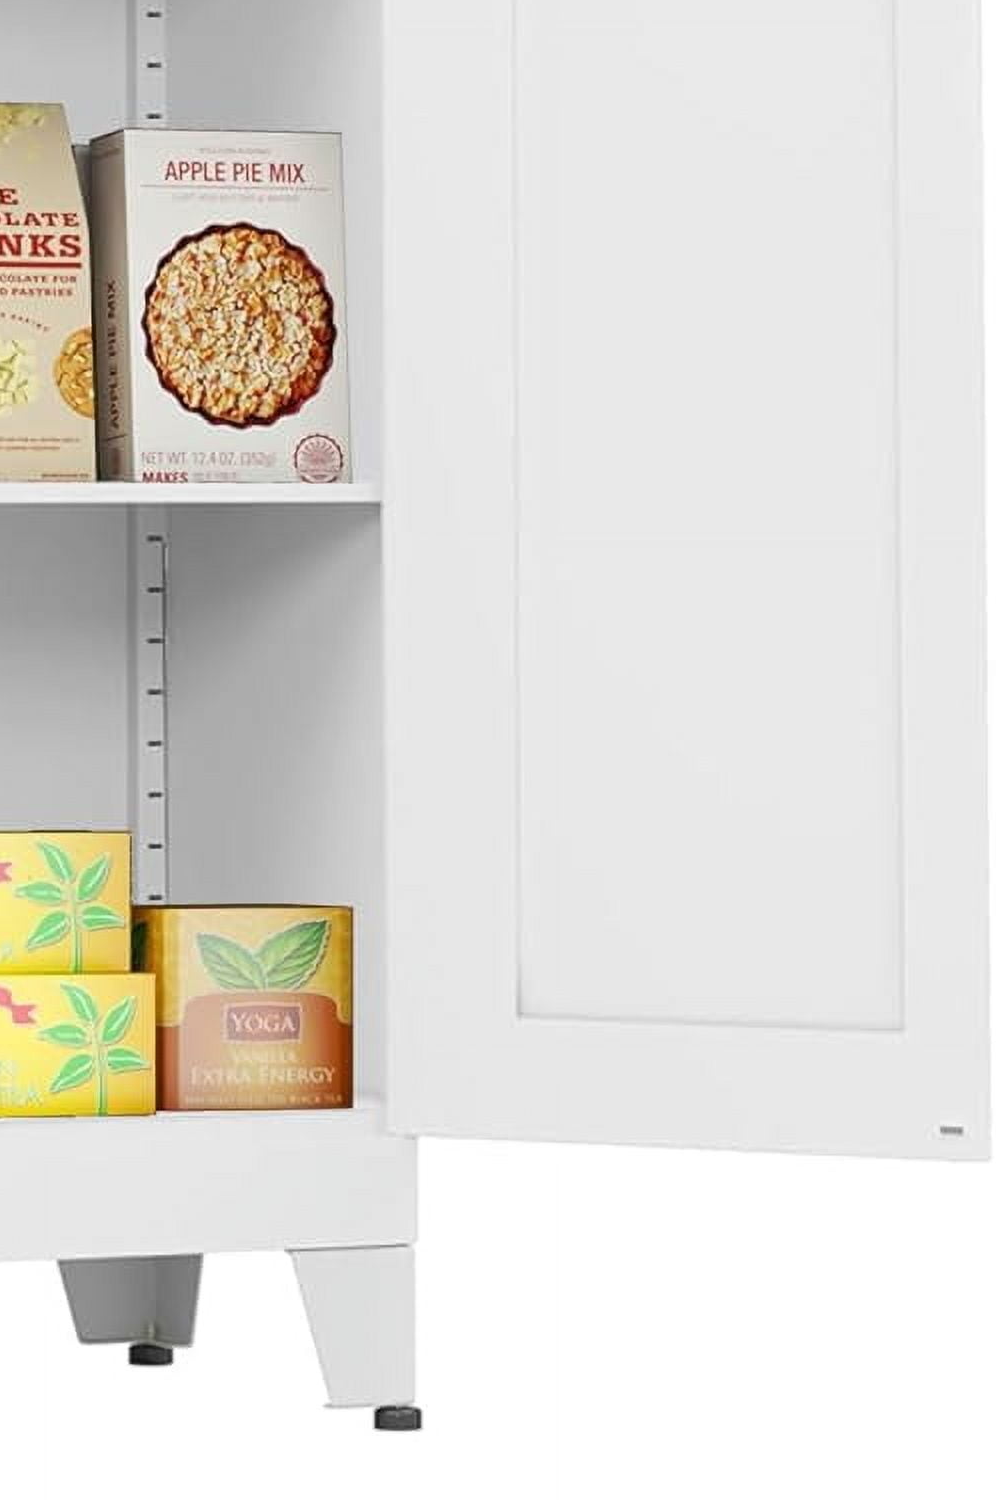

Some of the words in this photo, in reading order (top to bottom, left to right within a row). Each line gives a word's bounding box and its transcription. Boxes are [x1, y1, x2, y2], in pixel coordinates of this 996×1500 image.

[164, 160, 226, 183] APPLE
[231, 161, 263, 183] PIE
[268, 162, 306, 184] MIX
[10, 287, 74, 298] PASTRIES
[142, 470, 189, 484] MAKES
[231, 1011, 297, 1034] YOGA
[190, 1065, 252, 1086] EXTRA
[258, 1064, 336, 1085] ENERGY
